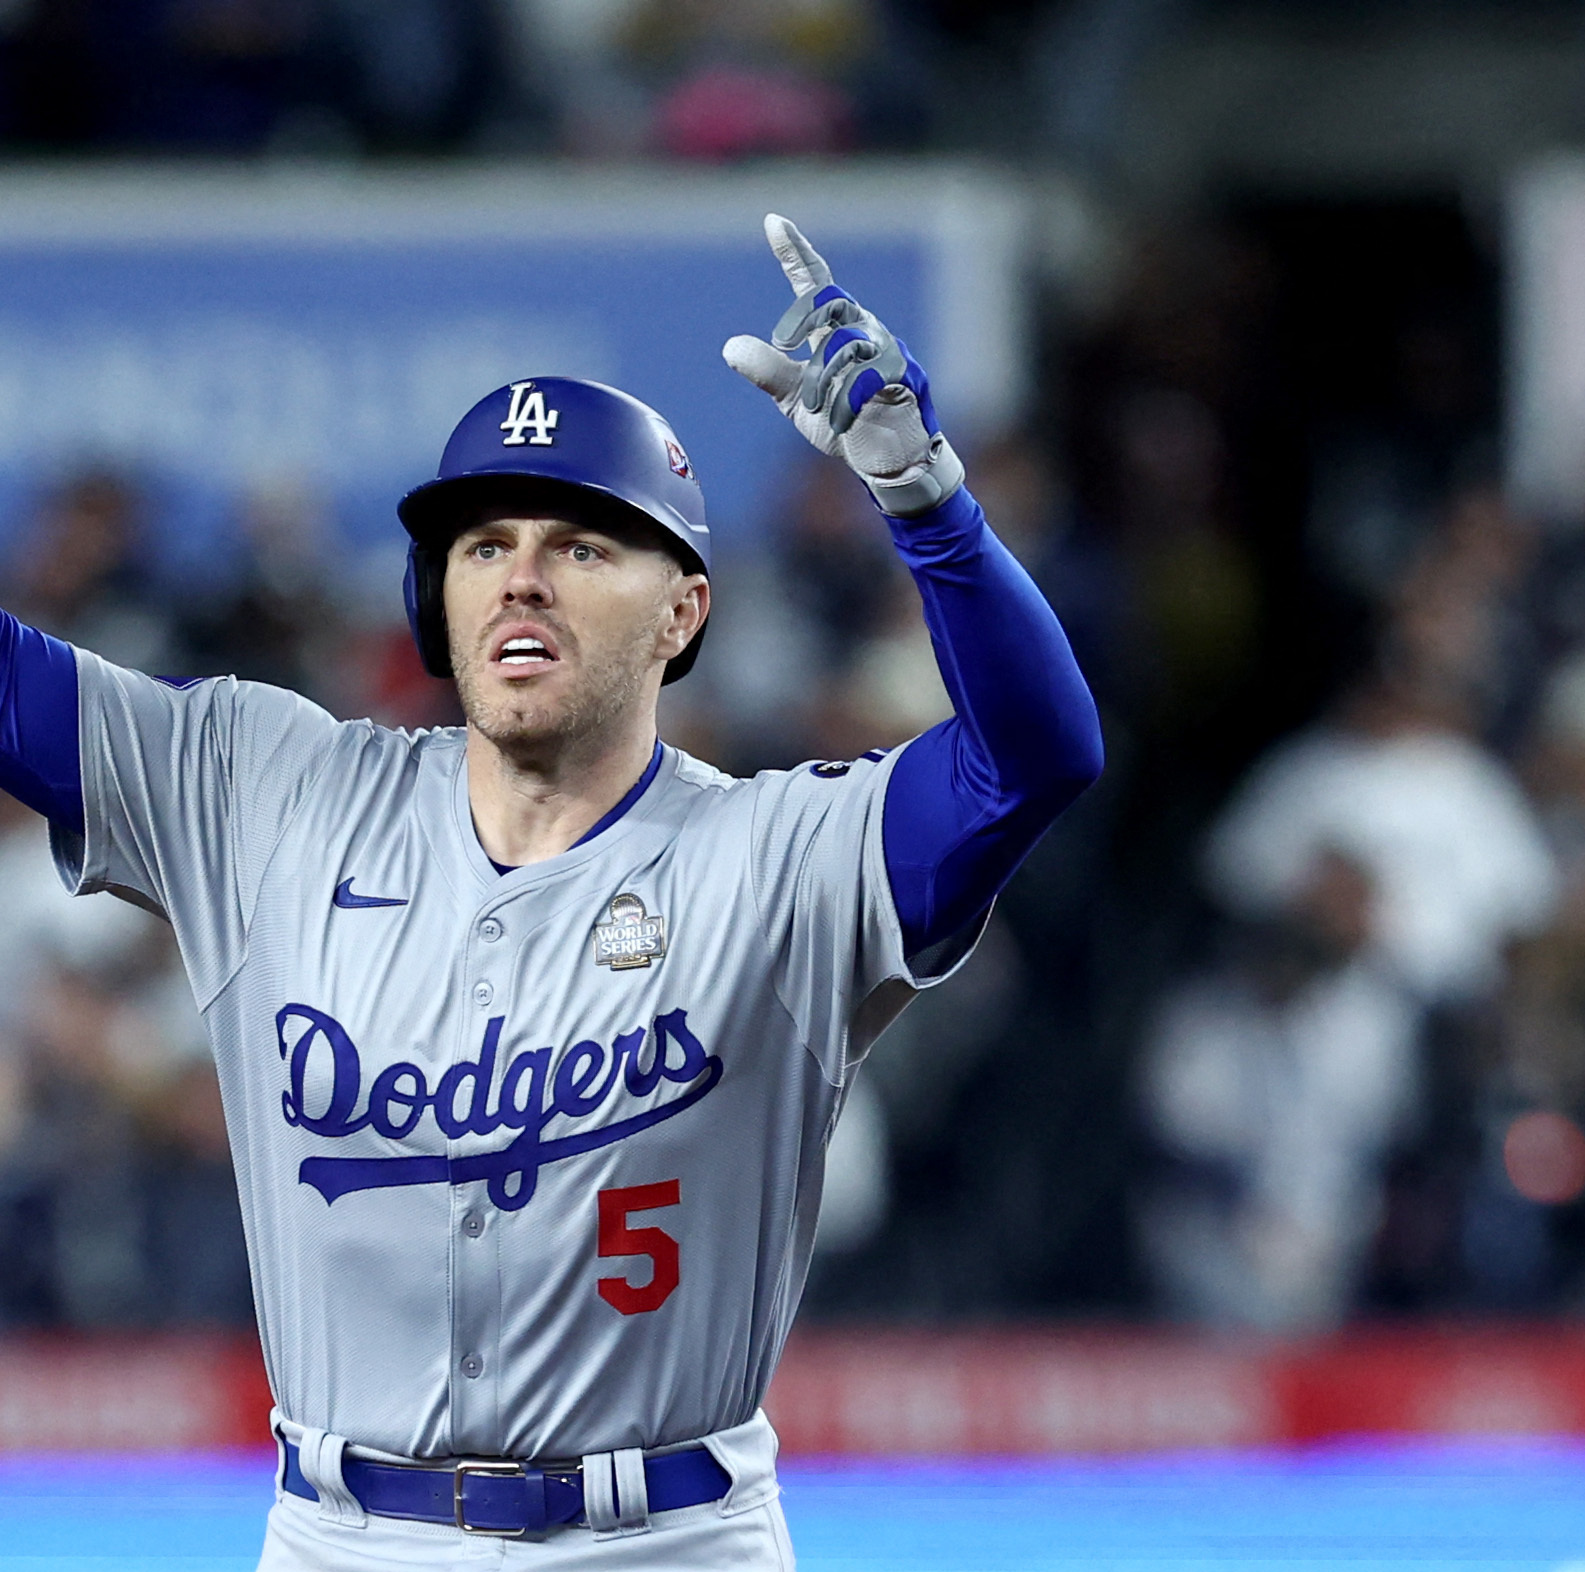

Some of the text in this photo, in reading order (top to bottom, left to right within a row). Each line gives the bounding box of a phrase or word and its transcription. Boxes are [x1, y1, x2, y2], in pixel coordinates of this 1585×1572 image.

[500, 382, 559, 445] LA
[598, 924, 657, 942] WORLD
[601, 937, 656, 955] SERIES
[275, 1003, 723, 1212] Dodgers
[598, 1179, 681, 1317] 5
